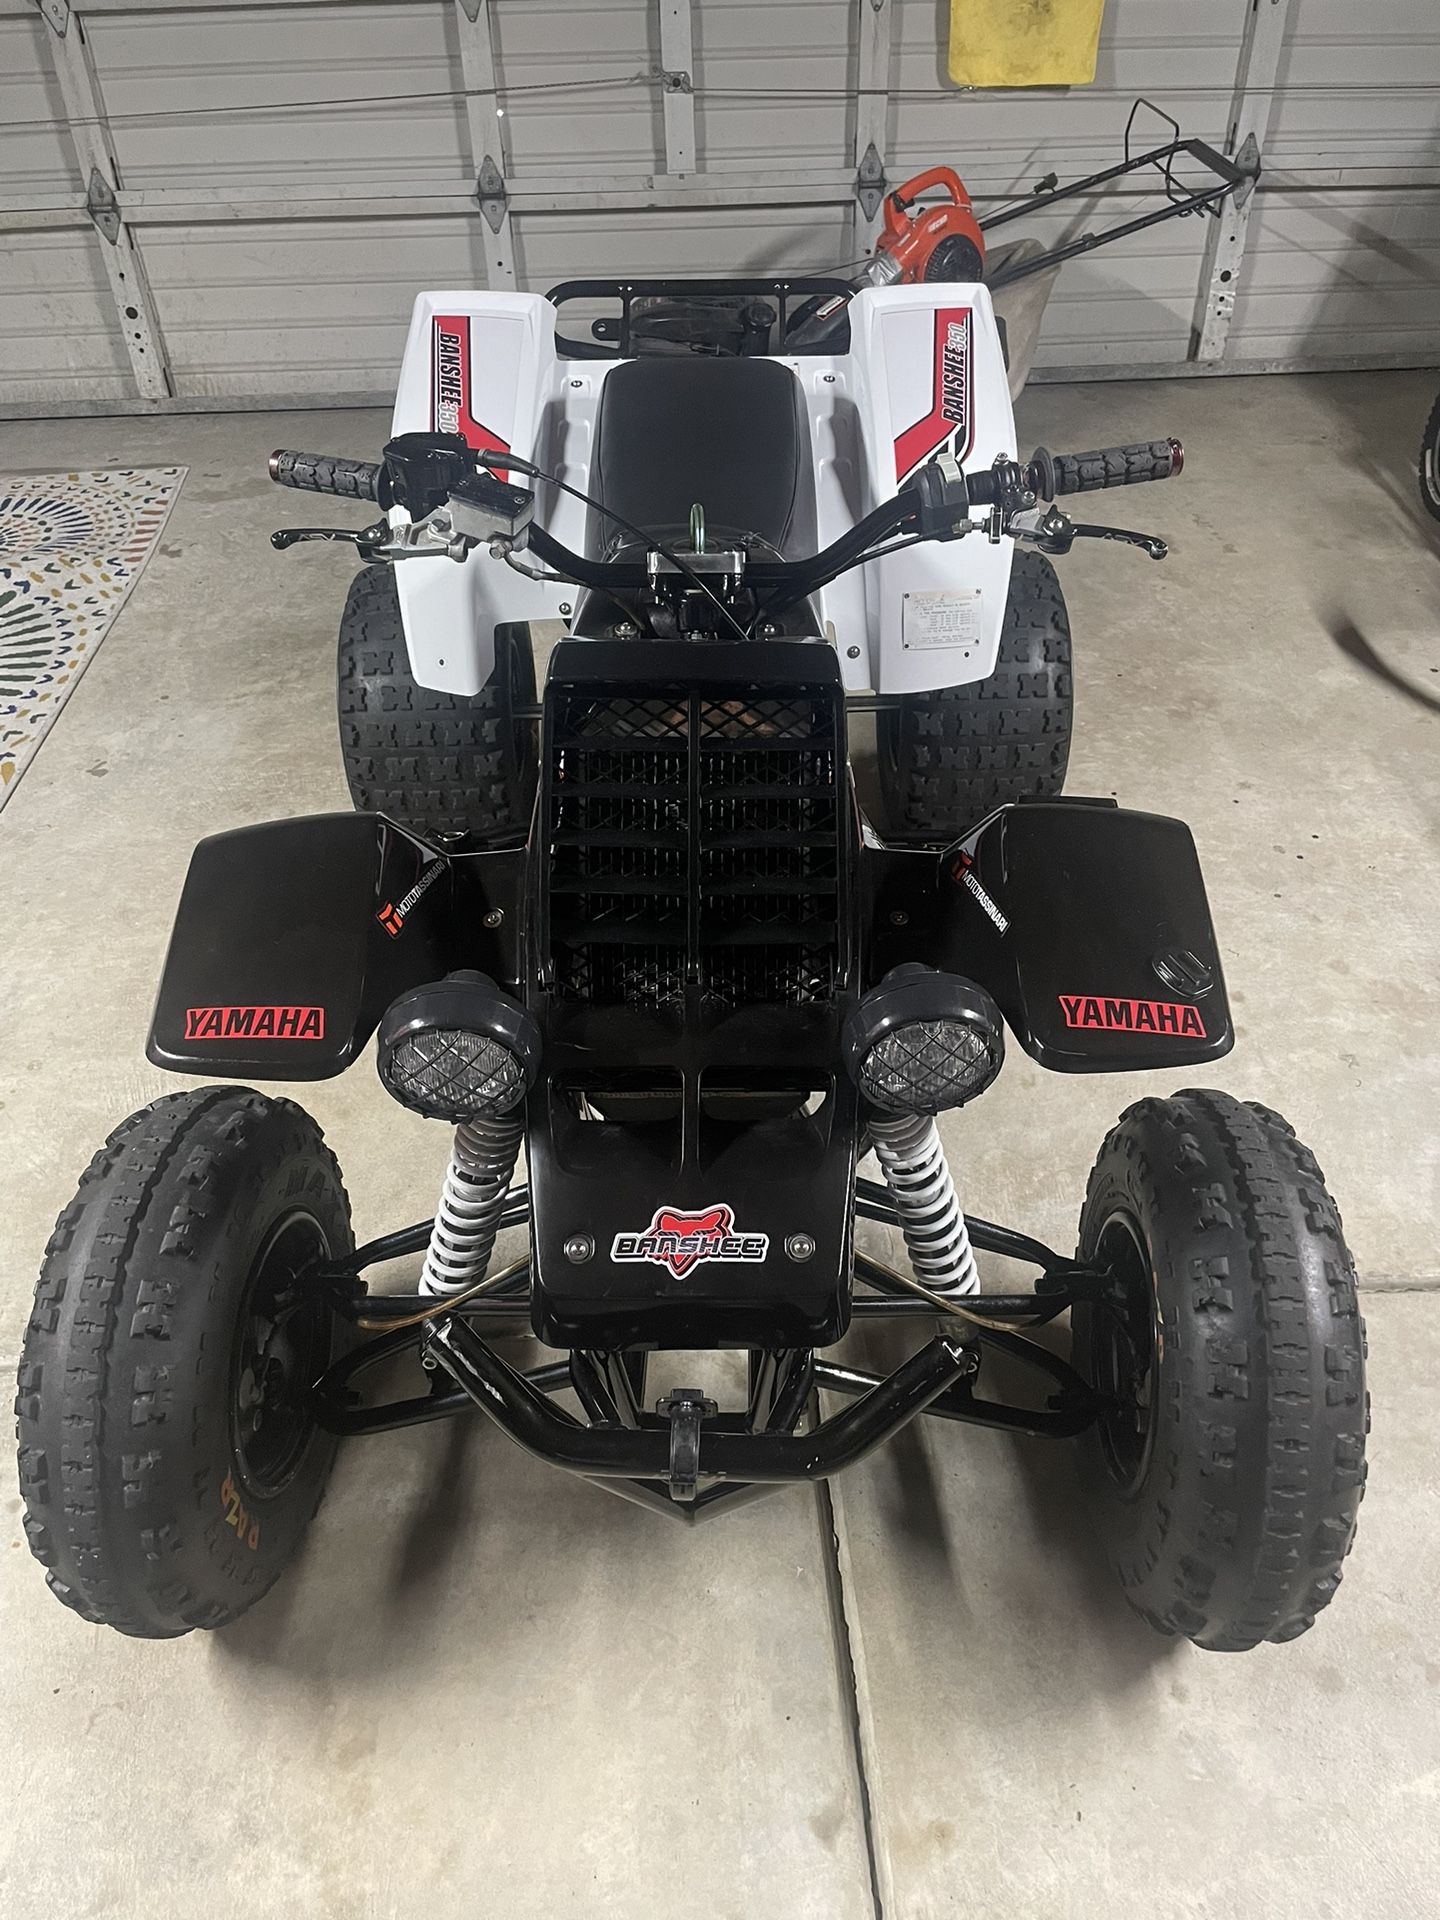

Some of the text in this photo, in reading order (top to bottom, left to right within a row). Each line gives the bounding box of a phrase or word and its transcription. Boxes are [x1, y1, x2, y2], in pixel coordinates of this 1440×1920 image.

[189, 1008, 320, 1037] YAMAHA
[1063, 998, 1203, 1036] YAMAHA
[614, 1236, 767, 1259] BANSHEE
